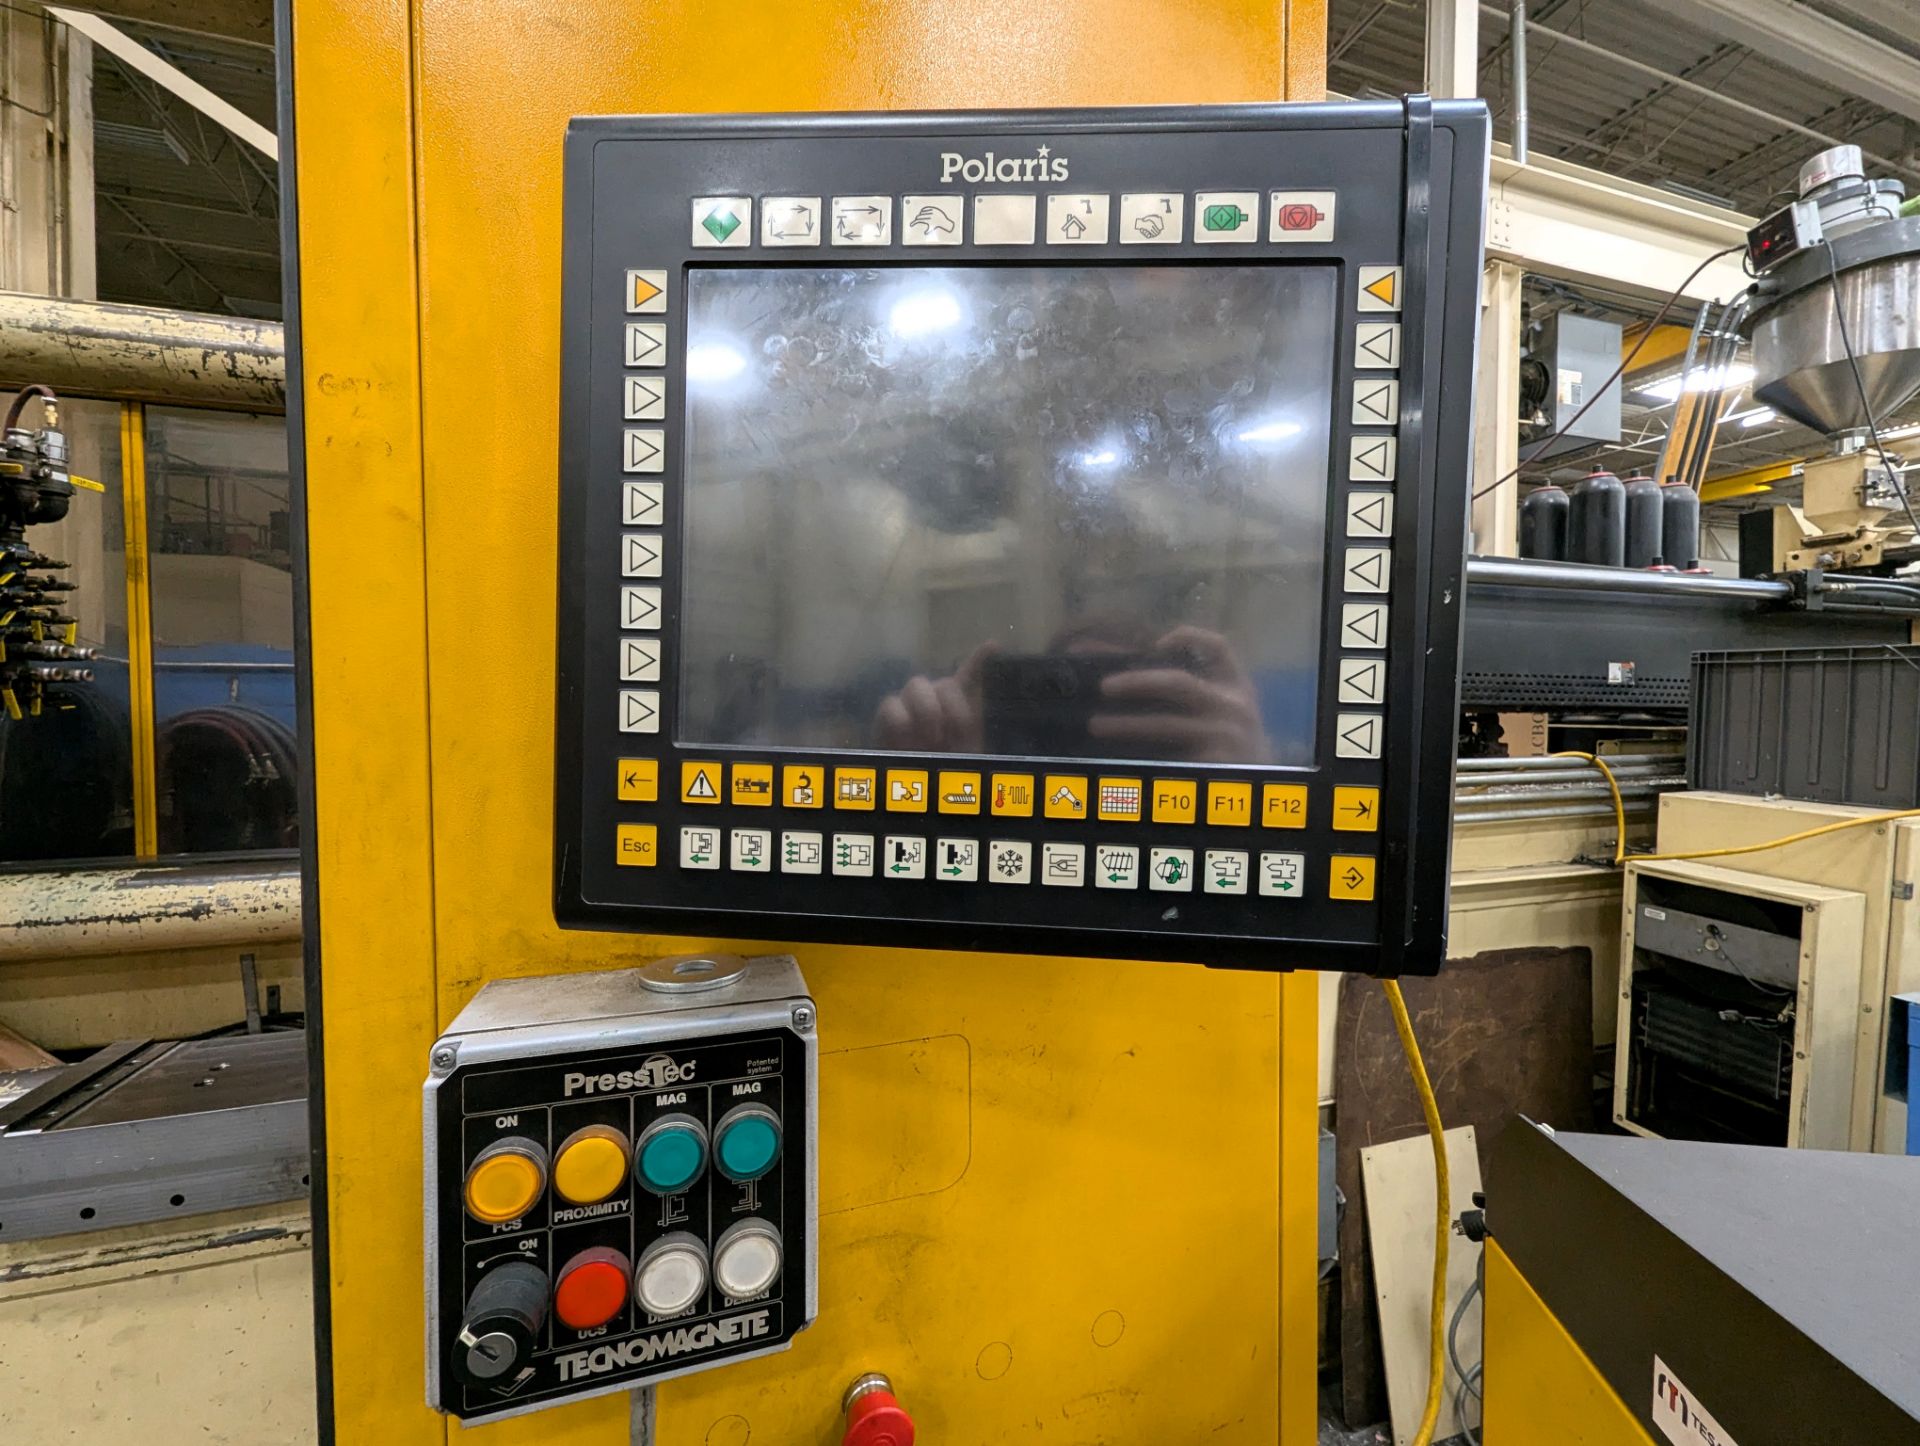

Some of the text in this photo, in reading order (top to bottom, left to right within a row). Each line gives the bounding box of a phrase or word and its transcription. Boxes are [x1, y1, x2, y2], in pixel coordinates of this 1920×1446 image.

[940, 144, 1069, 183] Polaris
[1158, 794, 1301, 814] F10 F11 F12
[623, 837, 651, 853] Esc
[564, 1058, 697, 1097] PressTec
[732, 1081, 762, 1096] MAG
[656, 1092, 687, 1107] MAG
[495, 1114, 519, 1129] ON
[554, 1199, 630, 1223] PROXIMITY
[519, 1238, 538, 1251] ON
[554, 1309, 770, 1382] TECNOMAGNETE
[1691, 1411, 1723, 1446] TES
